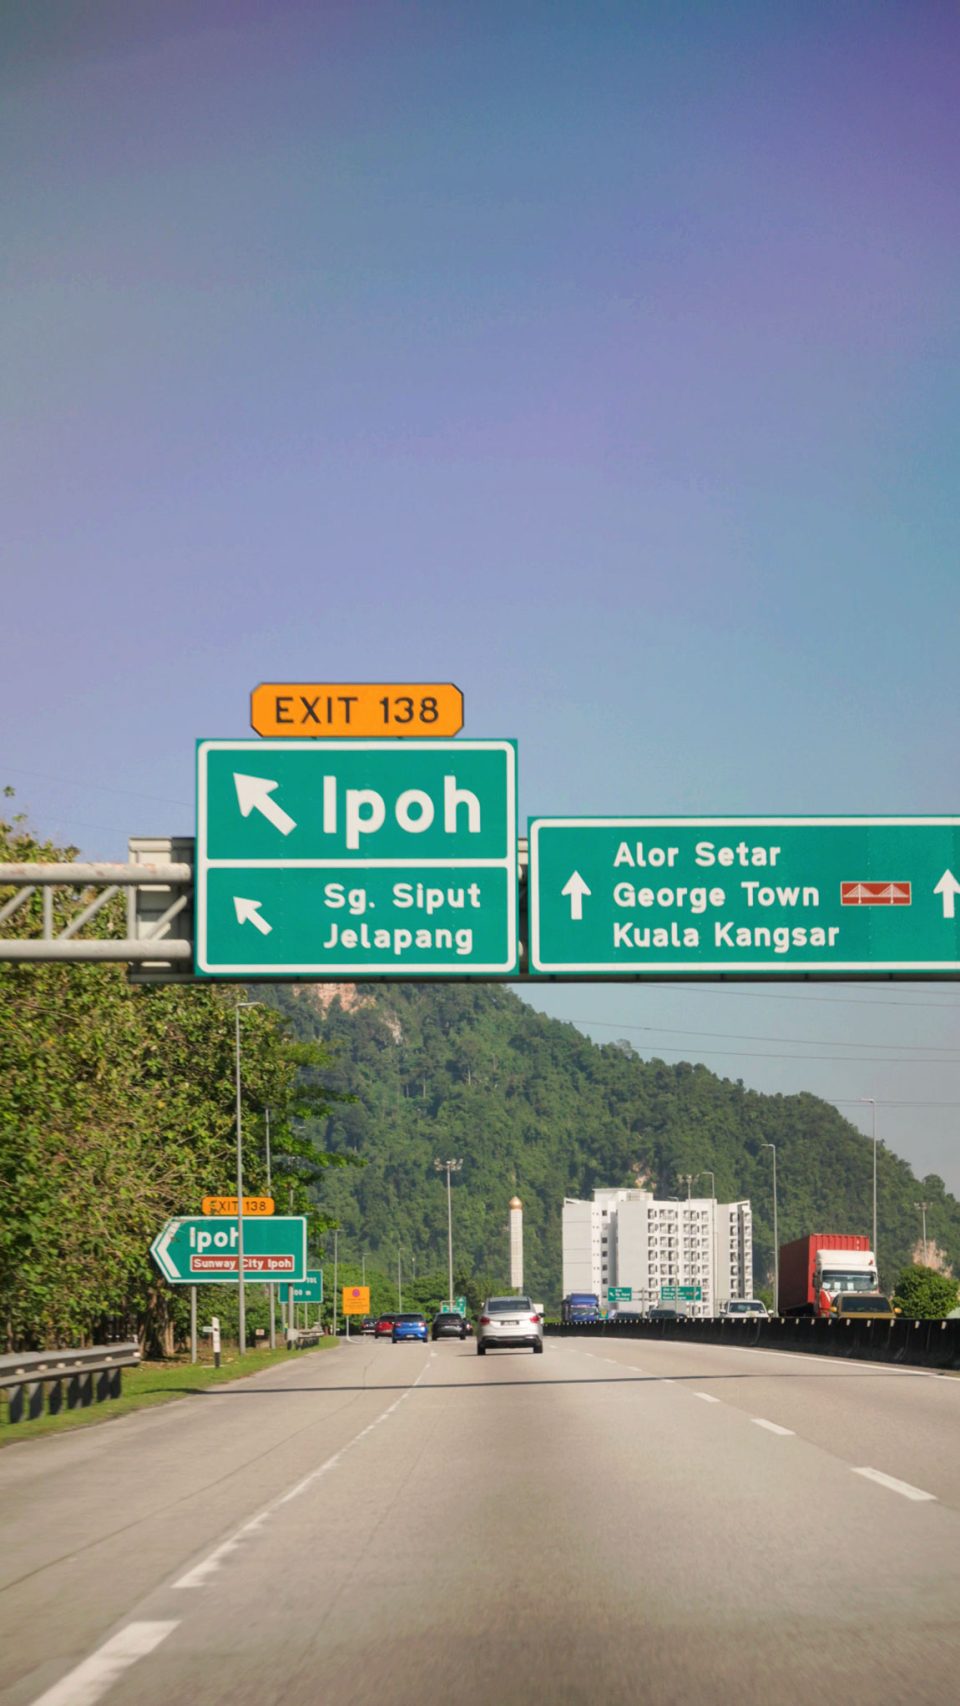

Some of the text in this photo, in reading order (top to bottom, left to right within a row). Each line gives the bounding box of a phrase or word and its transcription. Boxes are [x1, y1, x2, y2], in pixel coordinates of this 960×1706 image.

[276, 697, 438, 723] EXIT 138
[324, 776, 480, 849] Ipoh
[614, 842, 780, 867] Alor Setar
[325, 883, 480, 914] Sg. Siput
[614, 882, 819, 913] George Town
[324, 924, 472, 954] Jelapang
[614, 922, 839, 953] Kuala Kangsar
[246, 1201, 266, 1211] 138
[194, 1259, 292, 1269] Sunway City Ipoh
